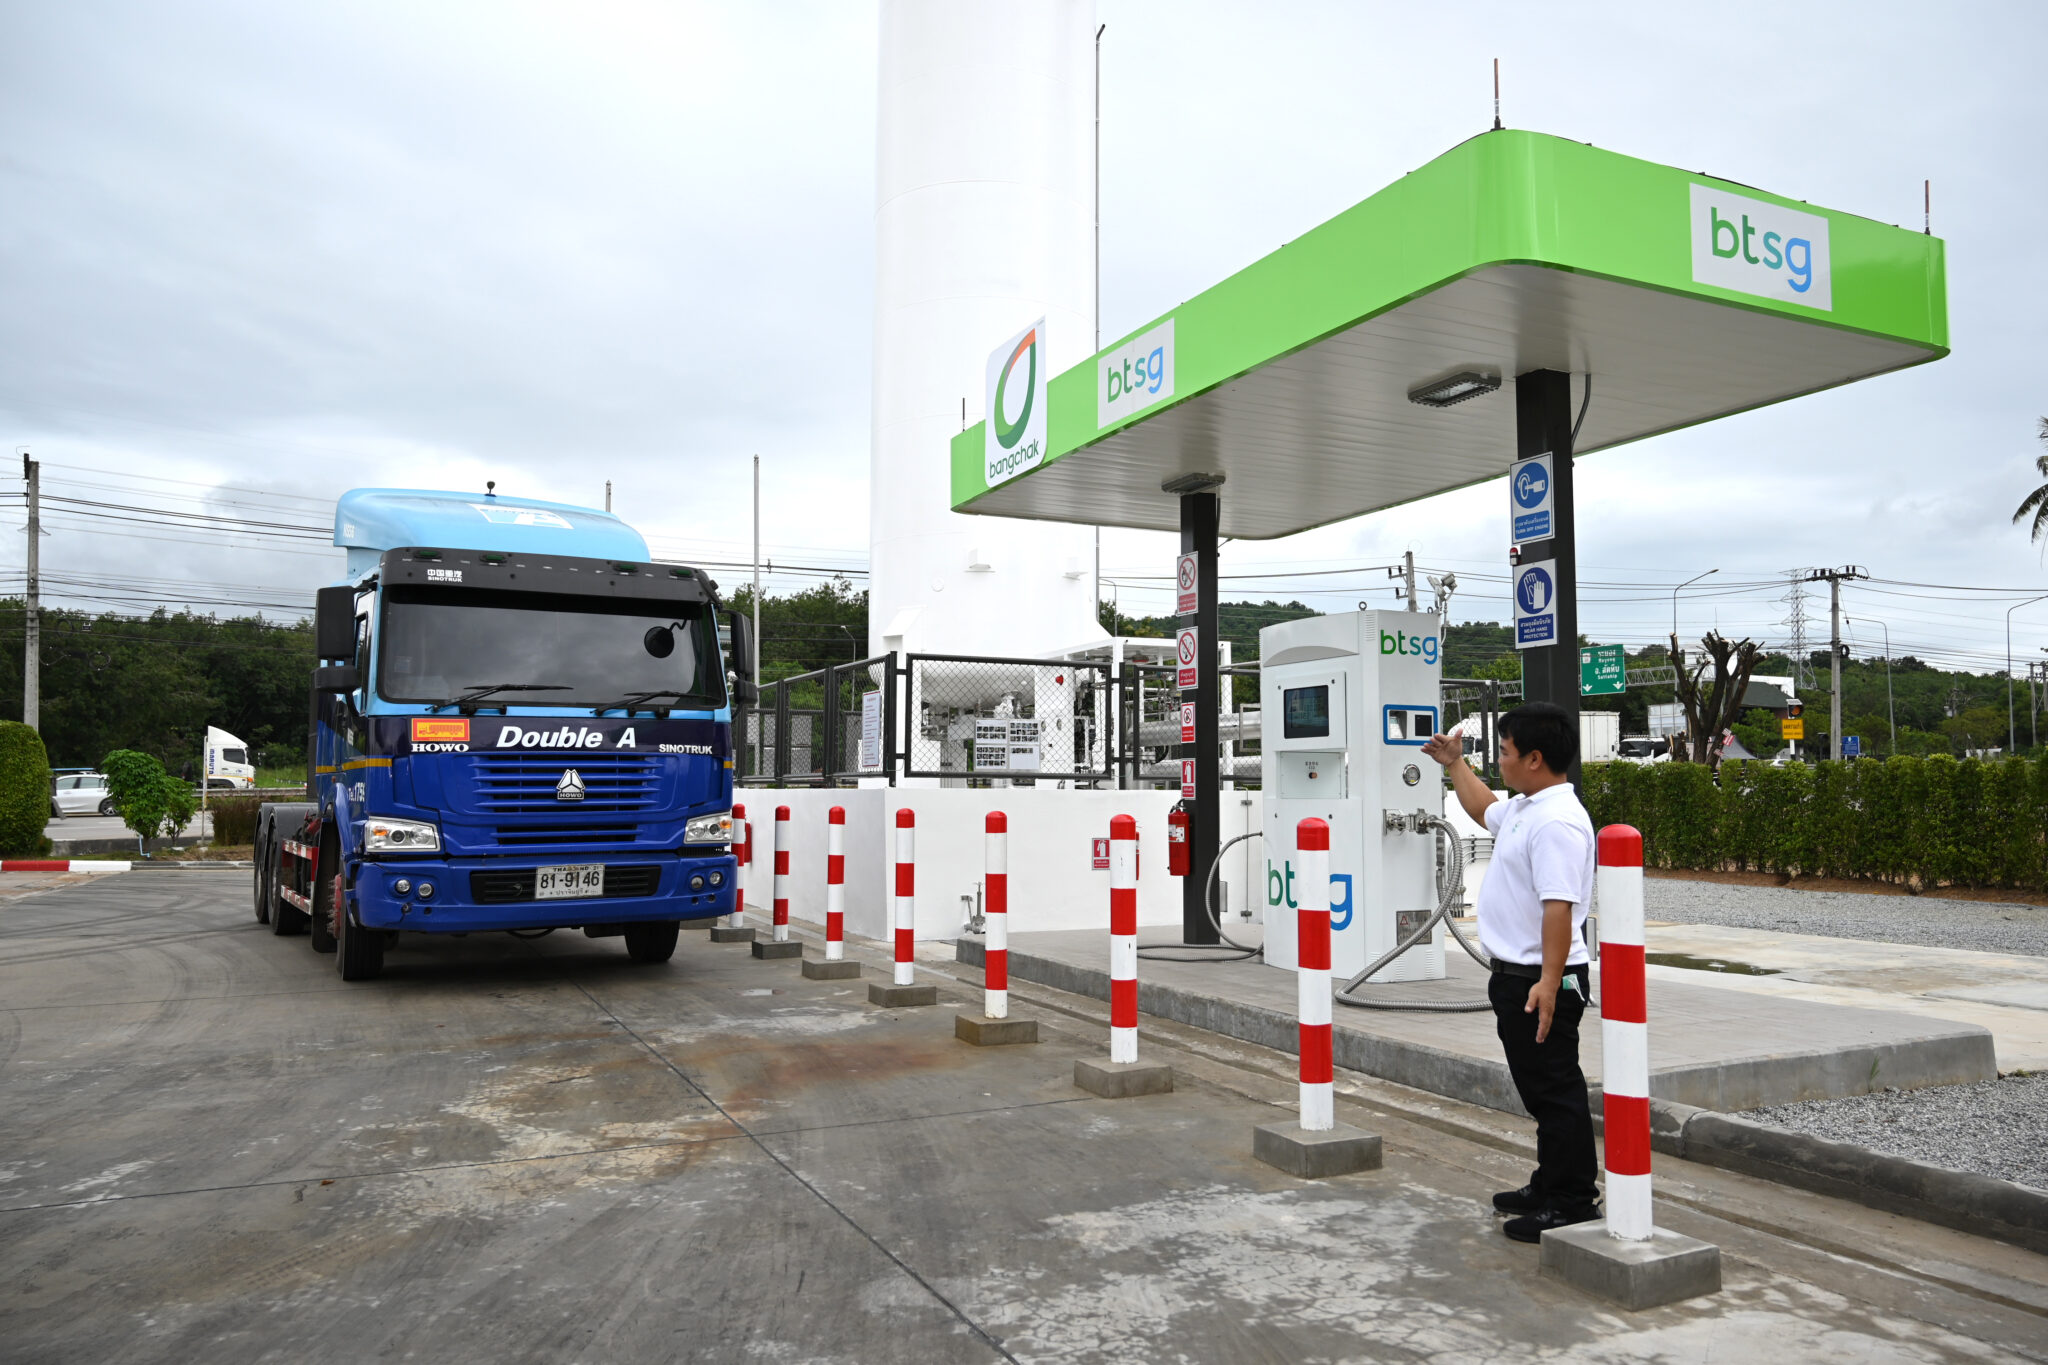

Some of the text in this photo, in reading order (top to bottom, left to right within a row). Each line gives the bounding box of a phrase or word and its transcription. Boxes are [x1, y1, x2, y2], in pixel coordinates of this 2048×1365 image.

[1710, 206, 1812, 293] btsg
[1107, 346, 1164, 404] btsg
[989, 438, 1039, 479] bangchak
[1380, 629, 1438, 665] btsg
[411, 743, 469, 752] HOWO
[496, 726, 636, 748] Double A
[658, 743, 713, 755] SINOTRUK
[540, 871, 600, 889] 81-9146
[1268, 859, 1353, 931] btg
